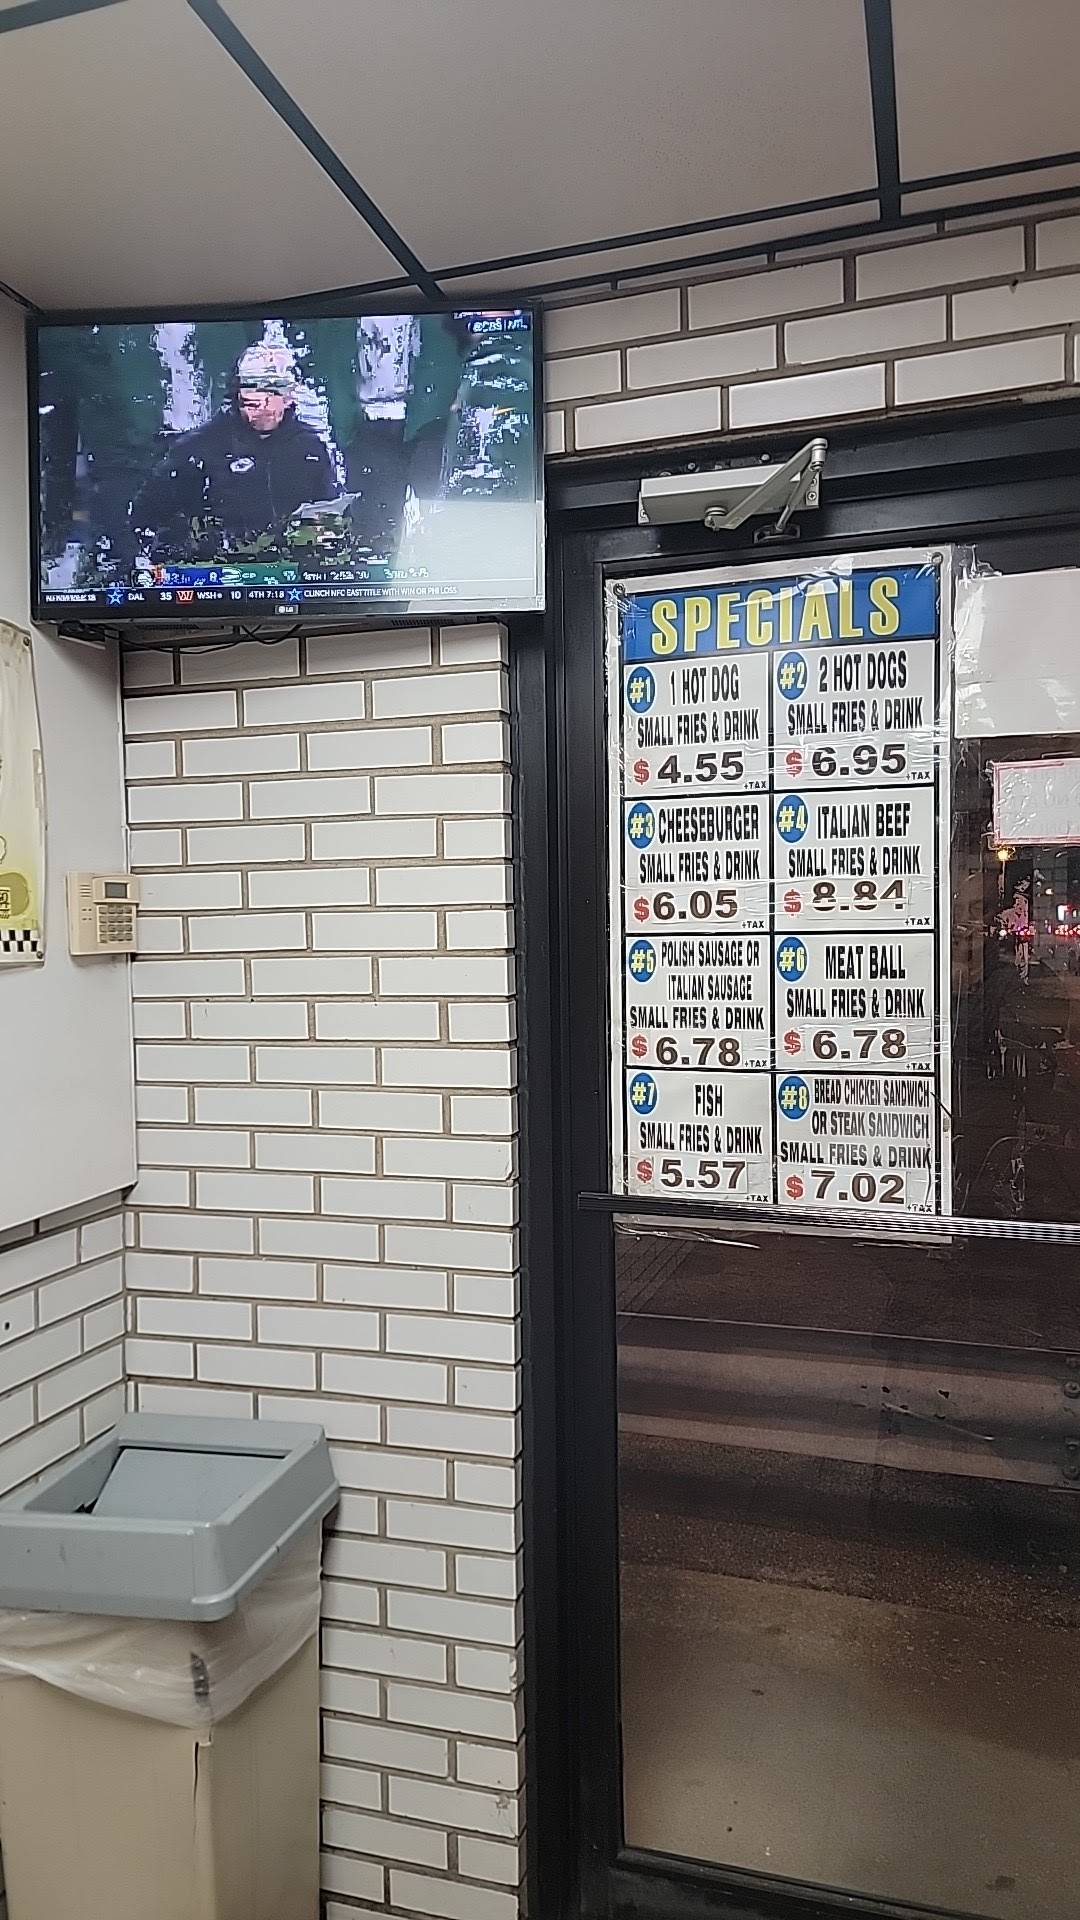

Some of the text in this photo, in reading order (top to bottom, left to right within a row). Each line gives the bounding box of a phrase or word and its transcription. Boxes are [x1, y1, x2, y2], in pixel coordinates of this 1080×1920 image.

[197, 591, 216, 600] WSH
[230, 591, 241, 600] 10
[249, 590, 284, 598] 4TH 7:18
[303, 590, 330, 598] CLINCH
[331, 589, 345, 597] NFC
[346, 589, 363, 597] EAST
[363, 588, 382, 596] TITLE
[382, 588, 400, 596] WITH
[401, 587, 415, 595] WIN
[416, 587, 427, 595] OR
[440, 586, 457, 594] LOSS
[651, 576, 899, 655] SPECIALS
[671, 664, 740, 705] 1 HOT DOG
[780, 662, 805, 689] #2
[819, 651, 906, 692] 2 HOT DOGS
[630, 676, 650, 703] #1
[637, 709, 759, 748] SMALL FRIES & DRINK
[788, 697, 923, 735] SMALL FRIES & DRINK
[744, 781, 767, 789] +TAX
[906, 772, 930, 780] +TAX
[630, 813, 654, 839] #3
[659, 805, 759, 843] CHEESEBURGER
[779, 805, 806, 832] #4
[818, 803, 910, 839] ITALIAN BEEF
[640, 850, 760, 883] SMALL FRIES & DRINK
[789, 846, 921, 877] SMALL FRIES & DRINK
[905, 918, 930, 926] +TAX
[631, 950, 654, 973] #5
[662, 940, 760, 966] POLISH SAUSAGE OR
[780, 947, 805, 971] #6
[825, 945, 905, 979] MEAT BALL
[668, 975, 752, 1000] ITALIAN SAUSAGE
[787, 988, 925, 1018] SMALL FRIES & DRINK
[630, 1005, 764, 1030] SMALL FRIES & DRINK
[906, 1063, 931, 1071] +TAX
[632, 1082, 655, 1105] #7
[695, 1084, 723, 1117] FISH
[781, 1086, 808, 1110] #8
[815, 1079, 930, 1107] BREAD CHICKEN SANDWICH
[640, 1122, 762, 1154] SMALL FRIES & DRINK
[812, 1111, 929, 1139] OR STEAK SANDWICH
[780, 1142, 931, 1169] SMALL FRIES & DRINK
[744, 1194, 769, 1202] +TAX
